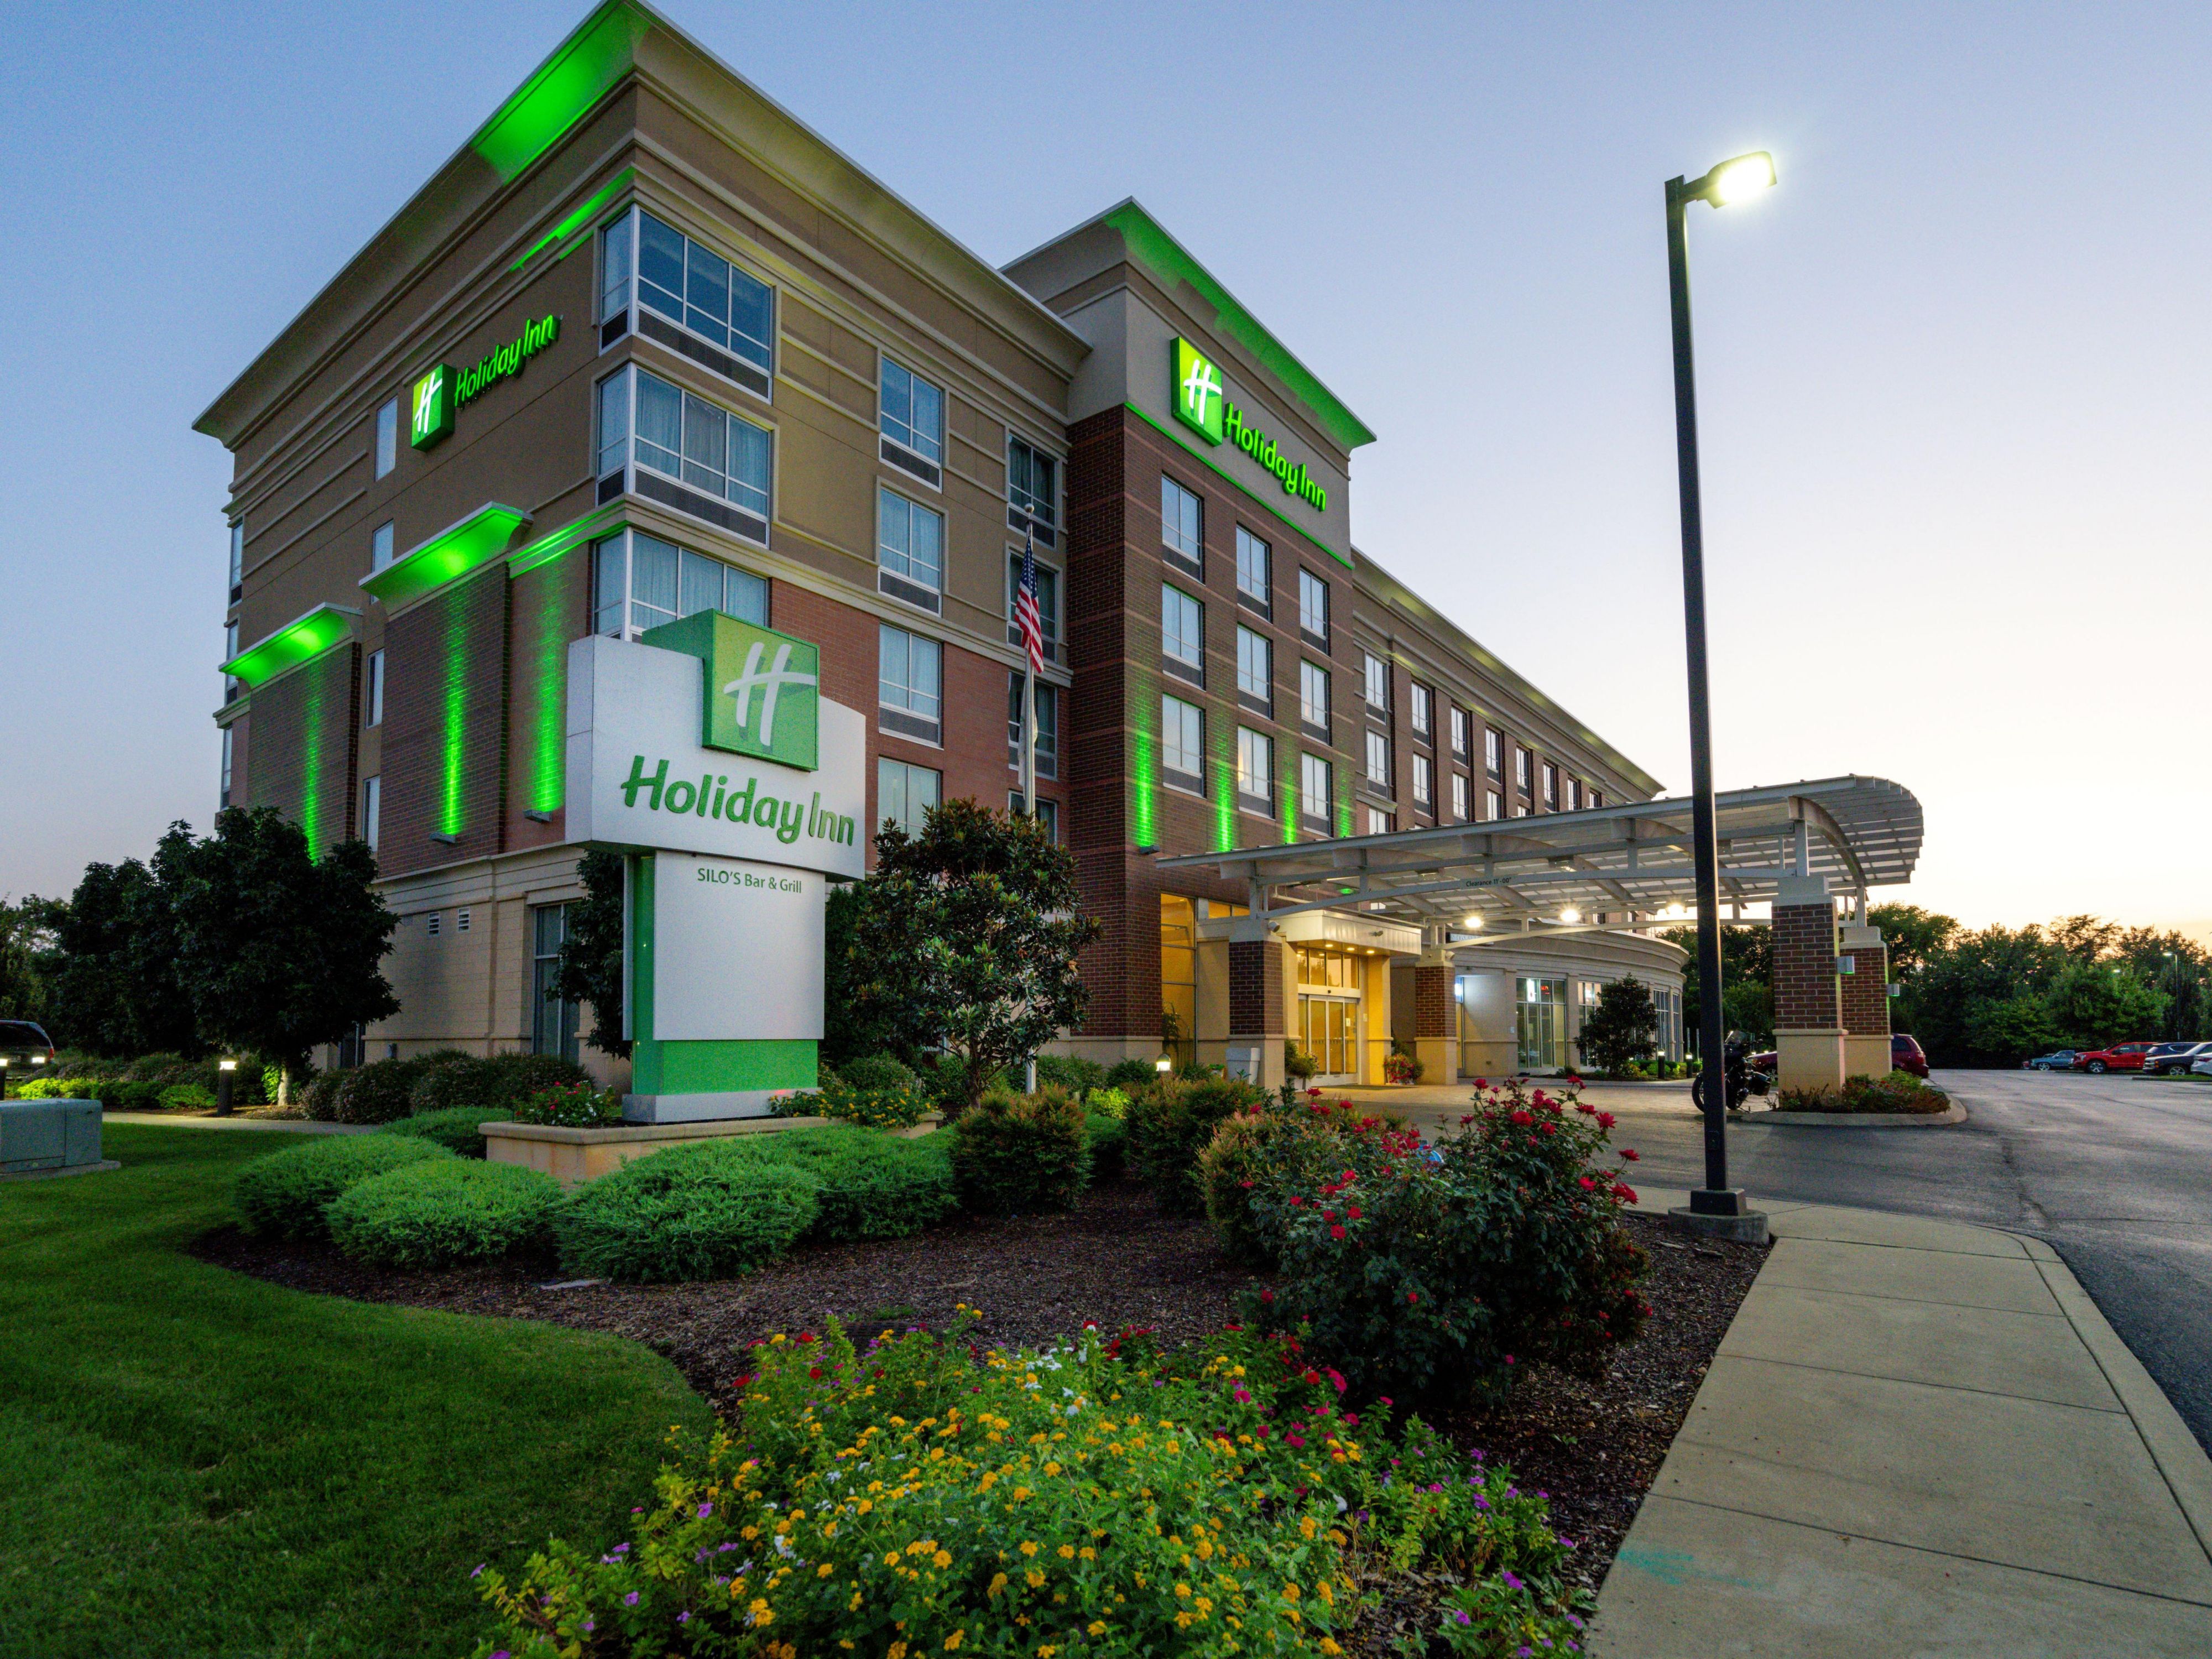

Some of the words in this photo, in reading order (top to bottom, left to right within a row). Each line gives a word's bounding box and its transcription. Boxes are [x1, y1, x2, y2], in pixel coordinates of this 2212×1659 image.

[455, 338, 521, 406] Holiday
[523, 314, 555, 356] Inn
[1224, 402, 1298, 494] Holiday
[1298, 463, 1327, 512] Inn
[620, 755, 805, 844] Holiday
[808, 791, 854, 846] Inn
[697, 868, 741, 885] SILO'S
[744, 873, 765, 888] Bar
[768, 877, 777, 890] &
[780, 878, 802, 894] Grill
